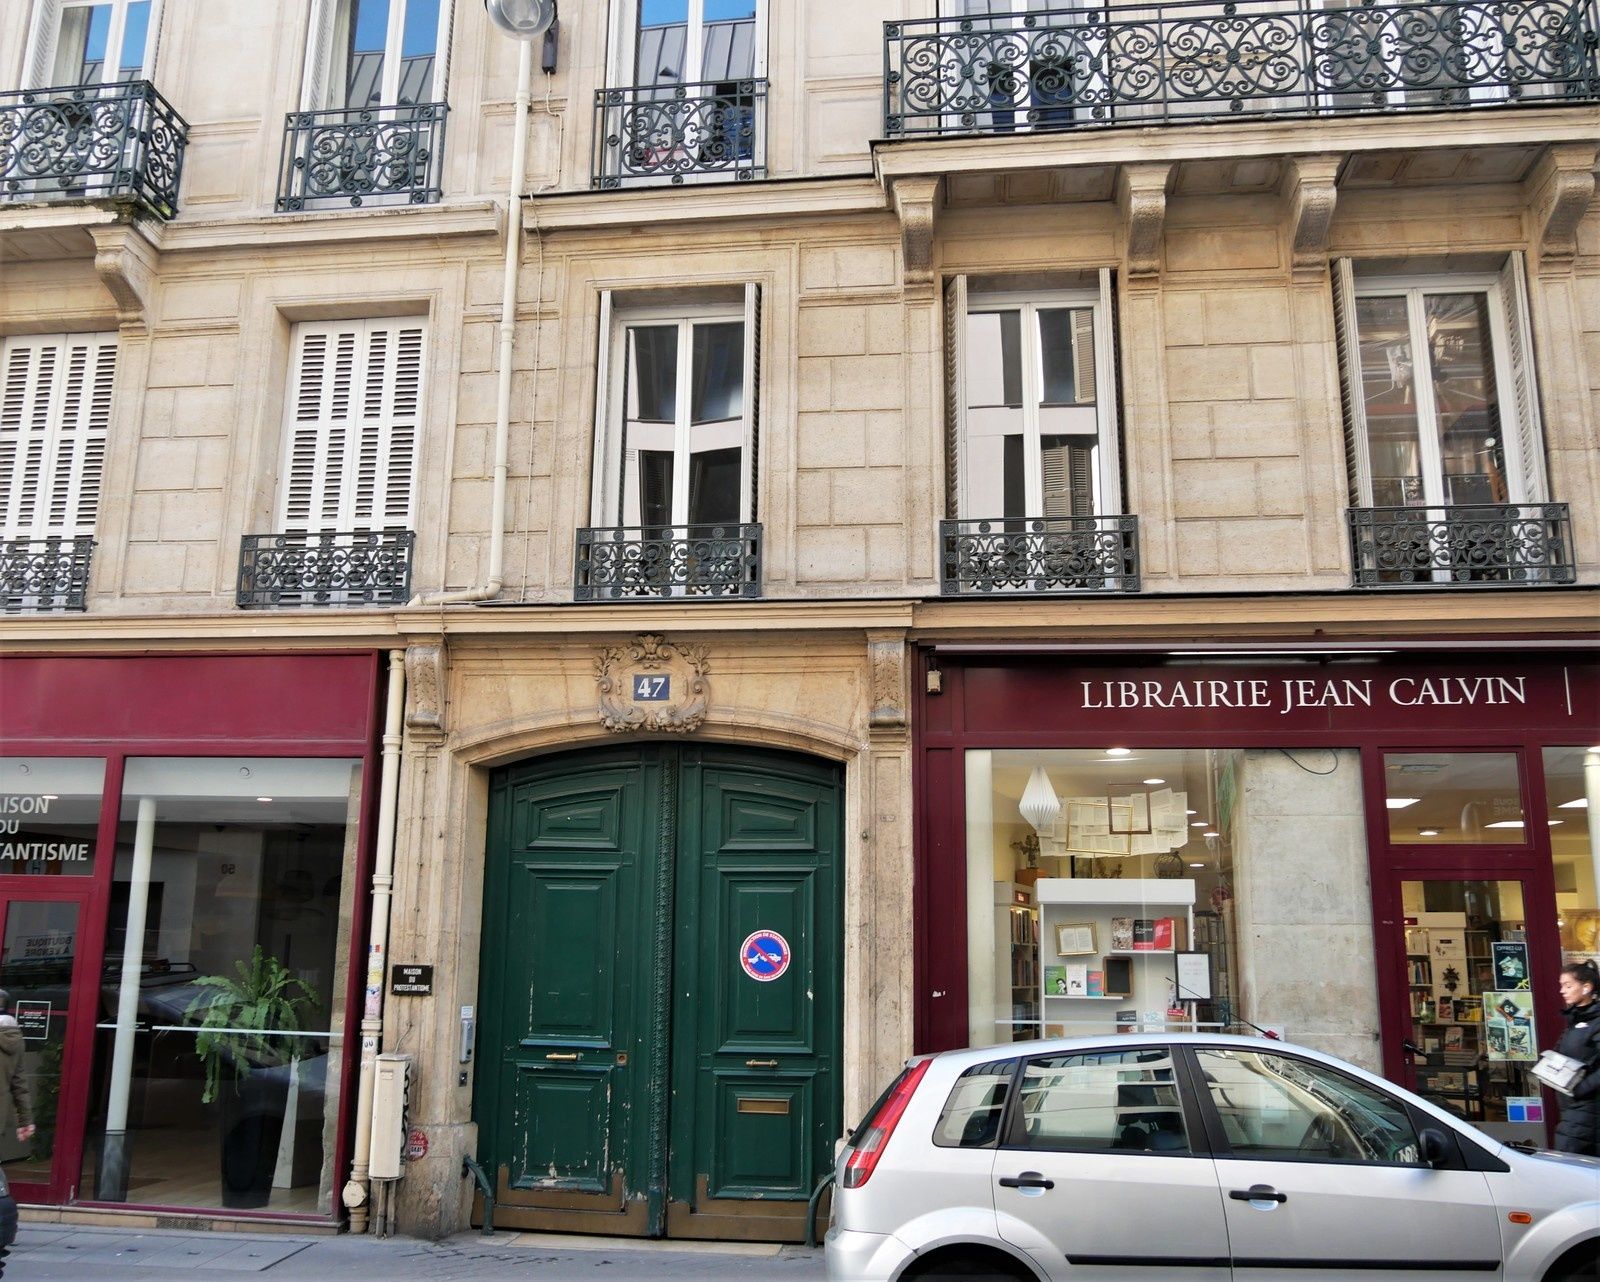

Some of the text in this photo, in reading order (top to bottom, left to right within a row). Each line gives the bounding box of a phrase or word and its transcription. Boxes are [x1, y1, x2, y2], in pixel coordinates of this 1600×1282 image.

[637, 677, 666, 698] 47
[1080, 676, 1526, 714] LIBRAIRIE JEAN CALVIN
[393, 984, 430, 992] PROTESTANTISME
